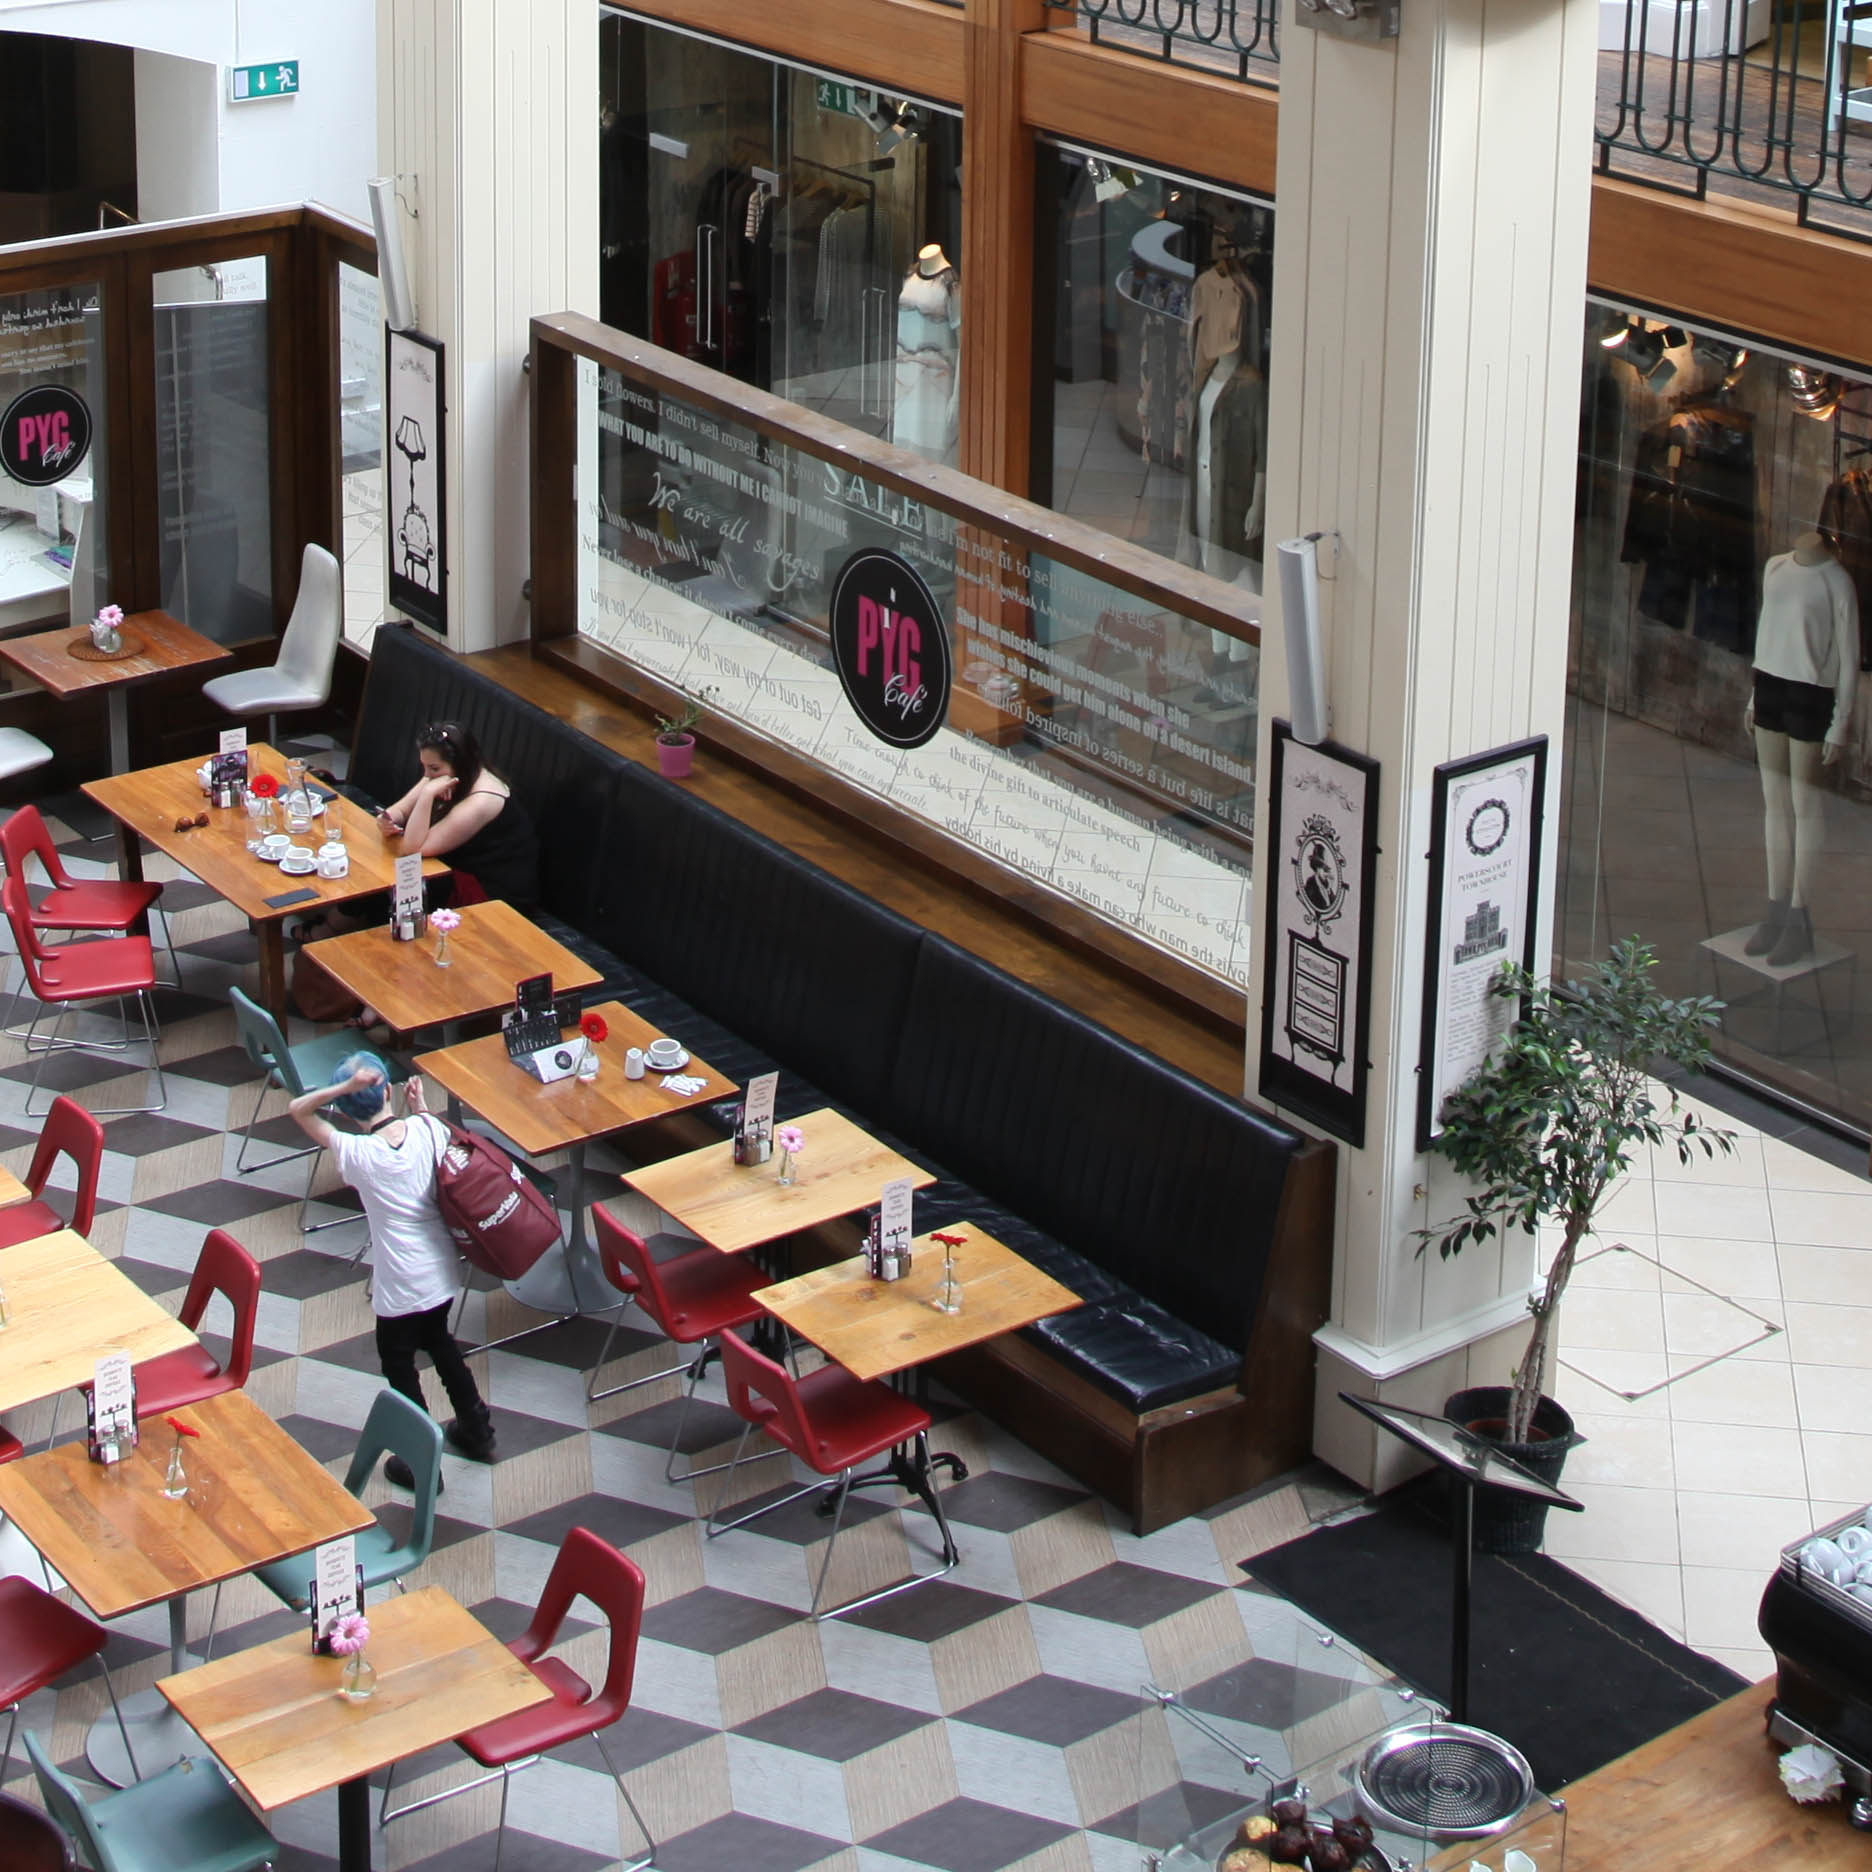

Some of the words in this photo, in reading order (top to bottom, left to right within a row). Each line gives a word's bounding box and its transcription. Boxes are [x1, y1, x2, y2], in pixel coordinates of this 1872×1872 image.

[19, 411, 70, 461] PYG
[625, 419, 644, 447] YOU
[645, 428, 663, 456] ARE
[665, 437, 677, 462] TO
[693, 450, 737, 489] WITHOUT
[740, 471, 753, 497] ME
[761, 481, 801, 518] CANNOT
[804, 500, 847, 539] IMAGINE
[648, 472, 681, 513] We
[684, 502, 710, 529] are
[719, 517, 750, 544] all
[753, 536, 820, 593] savages
[665, 402, 697, 433] didn't
[699, 417, 719, 442] sell
[971, 538, 992, 563] not
[998, 549, 1011, 571] fit
[1016, 559, 1030, 580] to
[1033, 565, 1056, 591] sell
[823, 461, 923, 532] SALE
[857, 593, 923, 695] PYG
[978, 614, 998, 641] has
[1133, 686, 1165, 719] when
[1168, 701, 1189, 730] she
[1007, 653, 1027, 680] she
[1030, 664, 1061, 696] could
[1063, 680, 1082, 707] get
[1084, 689, 1105, 717] him
[1107, 701, 1141, 733] alone
[1143, 720, 1157, 742] on
[1170, 730, 1210, 767] desert
[845, 725, 869, 753] Time
[958, 783, 970, 816] of
[994, 802, 1029, 846] future
[1063, 843, 1084, 871] you
[1126, 875, 1145, 904] any
[1152, 883, 1190, 930] future
[949, 743, 967, 767] the
[969, 752, 1004, 785] divine
[1005, 771, 1025, 798] gift
[1027, 783, 1039, 803] to
[1042, 790, 1098, 834] articulate
[1100, 818, 1140, 857] speech
[1108, 797, 1151, 831] human
[1152, 819, 1190, 855] being
[1193, 839, 1220, 866] with
